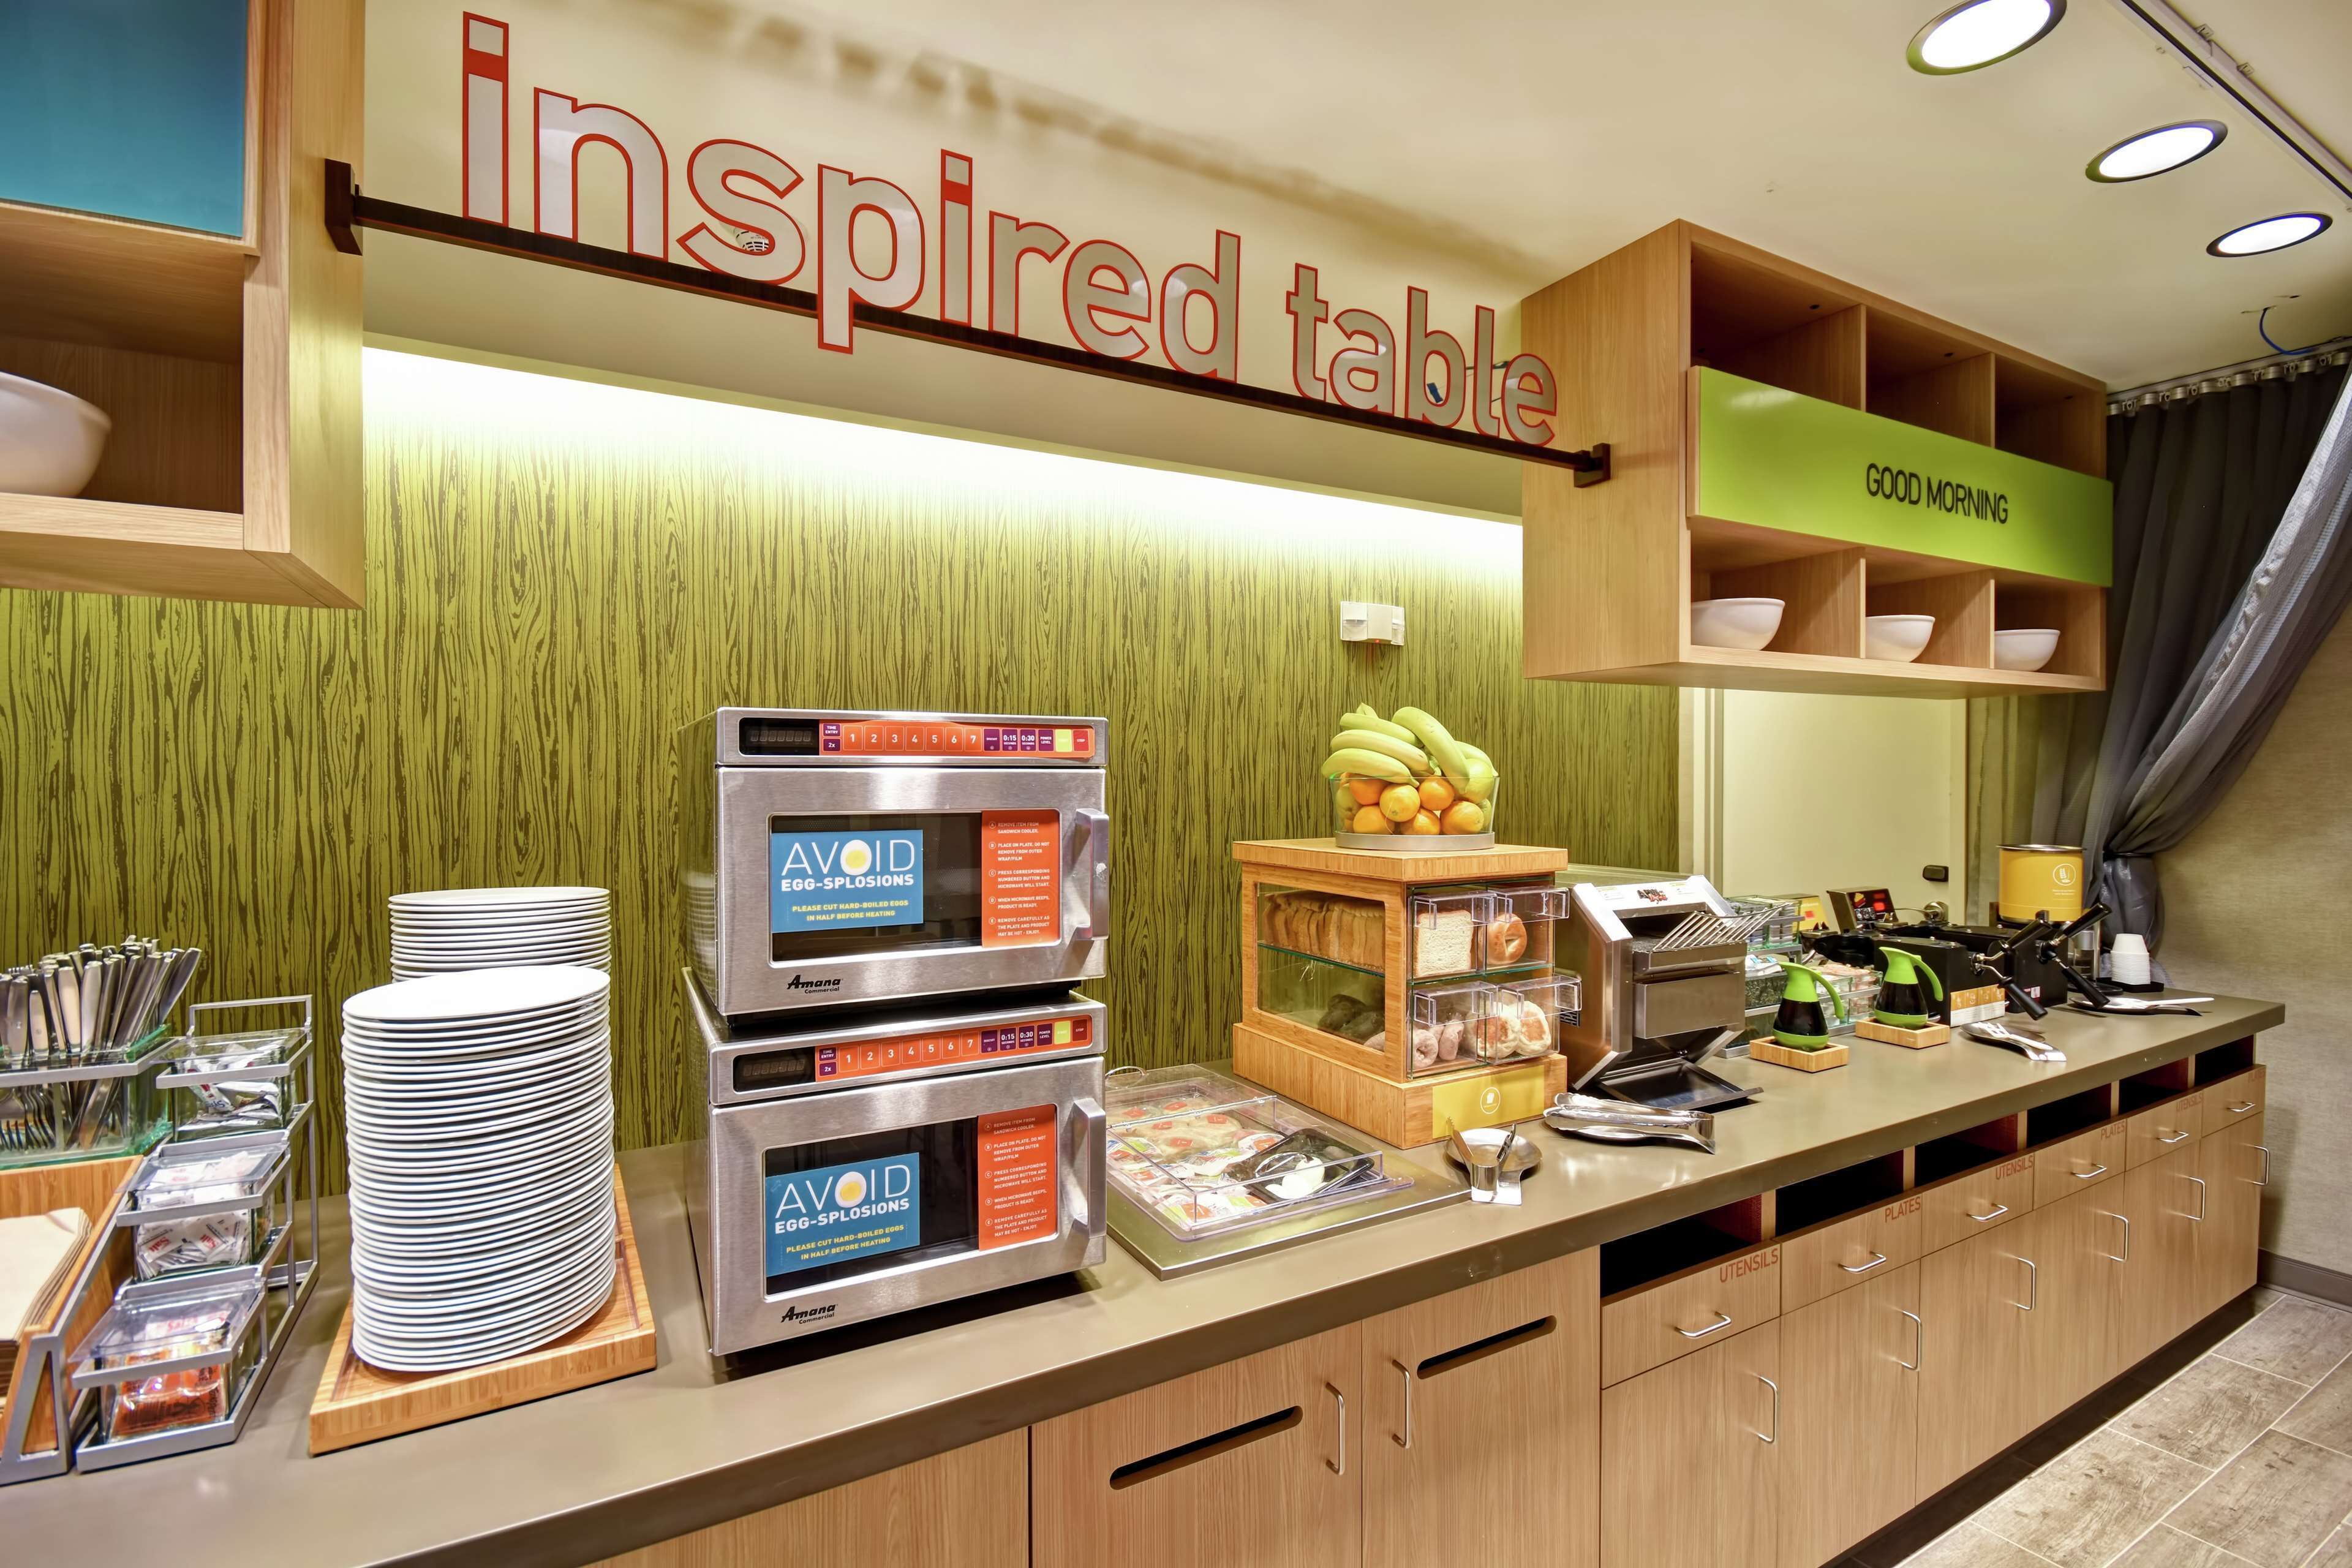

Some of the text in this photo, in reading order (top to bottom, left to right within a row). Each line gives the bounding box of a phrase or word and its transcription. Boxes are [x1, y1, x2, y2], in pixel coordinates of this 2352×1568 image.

[463, 11, 1557, 447] inspired table
[1866, 462, 2008, 524] GOOD MORNING
[850, 734, 855, 742] 1
[871, 734, 877, 743] 2
[892, 734, 898, 743] 3
[932, 735, 938, 744] 5
[970, 736, 976, 744] 7
[781, 839, 915, 876] AVOID
[781, 874, 914, 892] EGG-SPLOSIONS
[839, 900, 888, 909] HARD-BOILED
[786, 974, 842, 990] Amana
[929, 1044, 934, 1053] 5
[948, 1042, 954, 1050] 6
[967, 1039, 973, 1048] 7
[867, 1052, 873, 1061] 2
[888, 1049, 894, 1058] 3
[908, 1047, 914, 1055] 4
[846, 1055, 851, 1063] 1
[2176, 1091, 2204, 1112] UTENSILS
[2100, 1120, 2126, 1141] PLATES
[1009, 1162, 1047, 1172] CORRESPONDING
[1995, 1155, 2034, 1180] UTENSILS
[775, 1164, 910, 1219] AVOID
[994, 1180, 1020, 1189] MICROWAVE
[775, 1198, 910, 1234] EGG-SPLOSIONS
[1014, 1210, 1041, 1219] CAREFULLY
[1884, 1196, 1921, 1223] PLATES
[148, 1236, 172, 1253] Salt
[200, 1234, 217, 1250] Salt
[786, 1242, 816, 1254] PLEASE
[834, 1229, 884, 1244] HARD-BOILED
[885, 1224, 904, 1234] EGGS
[811, 1250, 830, 1258] HALF
[831, 1243, 859, 1254] BEFORE
[861, 1237, 891, 1248] HEATING
[1719, 1247, 1779, 1284] UTENSILS
[780, 1304, 836, 1323] Amana
[799, 1312, 835, 1324] Commercial
